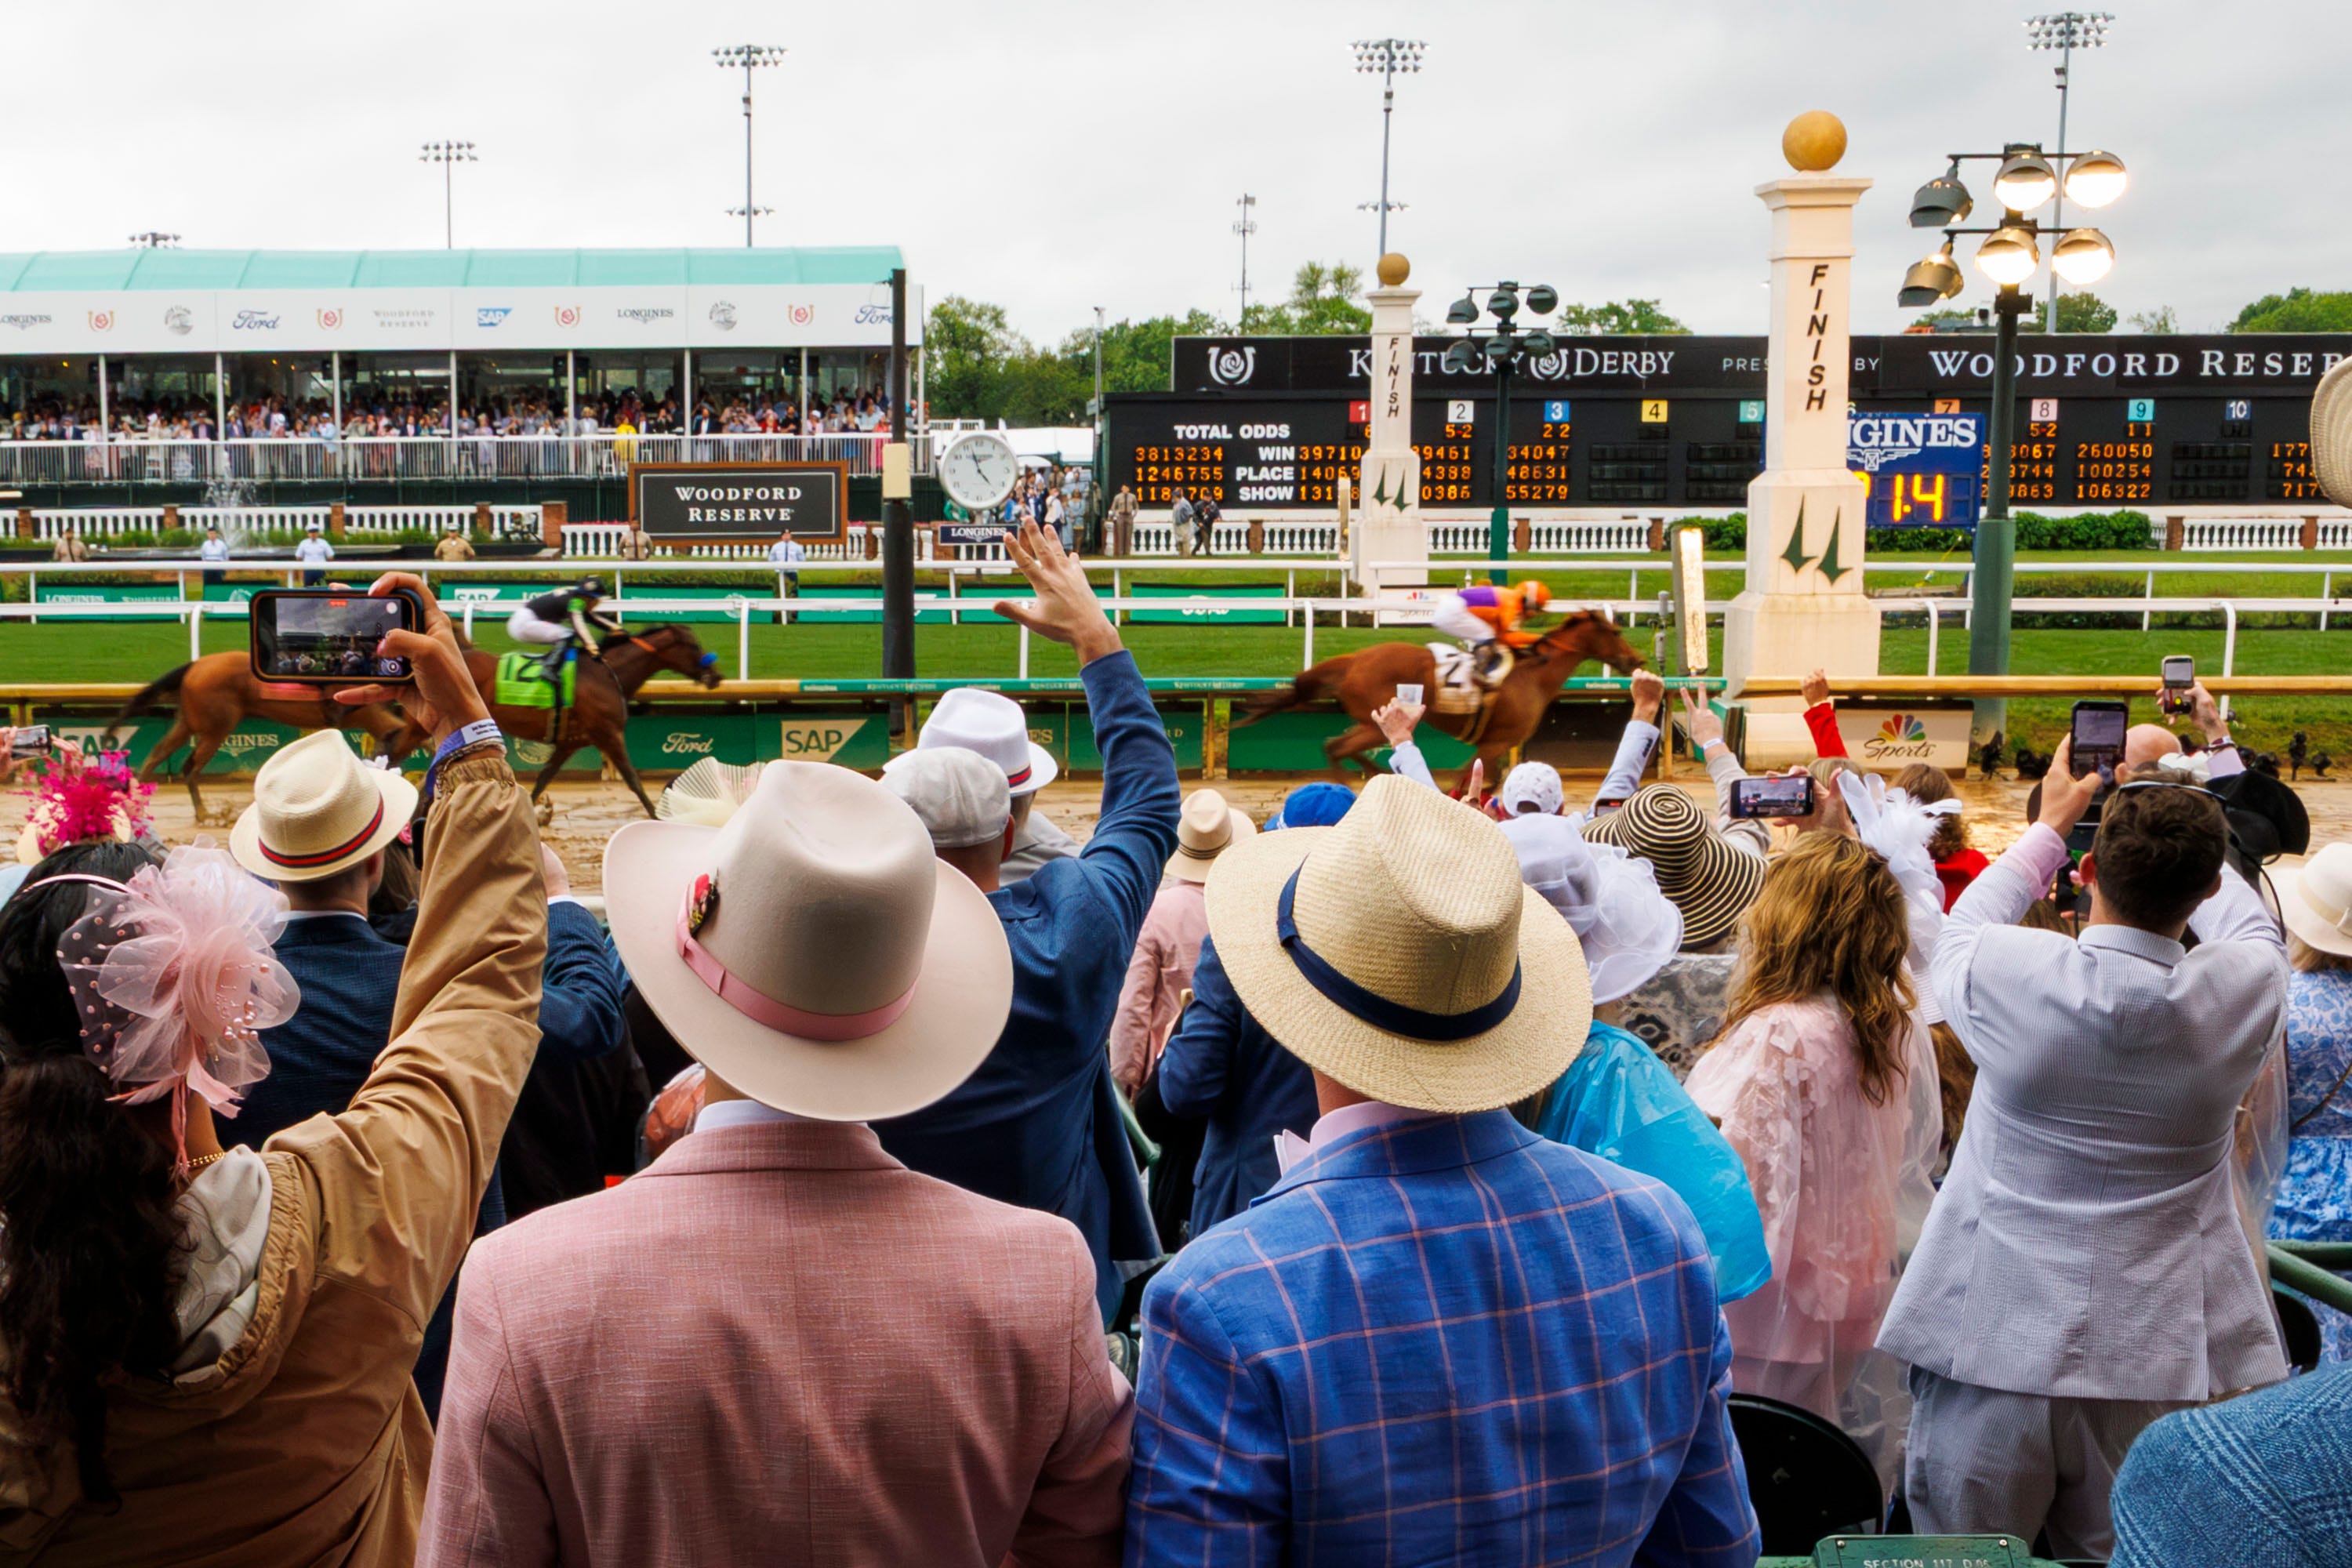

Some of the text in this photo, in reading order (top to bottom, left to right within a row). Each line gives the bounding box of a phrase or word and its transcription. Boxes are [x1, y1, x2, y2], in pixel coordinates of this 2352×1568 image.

[232, 309, 281, 330] Ford
[478, 310, 506, 325] SAP
[617, 308, 674, 318] LONGINES
[1806, 264, 1829, 411] FINISH
[1573, 349, 1675, 379] DERBY
[1854, 358, 1880, 371] BY
[2199, 350, 2344, 376] RESER
[1387, 337, 1399, 418] FINISH
[1358, 403, 1367, 421] 1
[1456, 403, 1466, 419] 2
[1551, 401, 1563, 420] 3
[1649, 403, 1661, 419] 4
[1746, 401, 1759, 419] 5
[1941, 401, 1953, 413] 7
[2039, 401, 2050, 418] 8
[2136, 401, 2147, 419] 9
[2229, 401, 2247, 419] 10
[1174, 424, 1290, 439] TOTAL ODDS
[1847, 418, 1977, 448] GINES
[1135, 446, 1223, 461] 3813234
[1258, 446, 1294, 461] WIN
[1299, 445, 1370, 461] 39710
[2273, 442, 2311, 458] 177
[1236, 466, 1294, 481] PLACE
[1300, 466, 1361, 481] 14069
[674, 486, 802, 501] WOODFORD
[1239, 486, 1294, 501] SHOW
[688, 507, 792, 522] RESERVE
[951, 527, 1007, 537] LONGINES
[662, 731, 714, 753] Ford
[785, 728, 843, 753] SAP
[1864, 737, 1937, 762] Sports
[1863, 1559, 1924, 1568] SECTION
